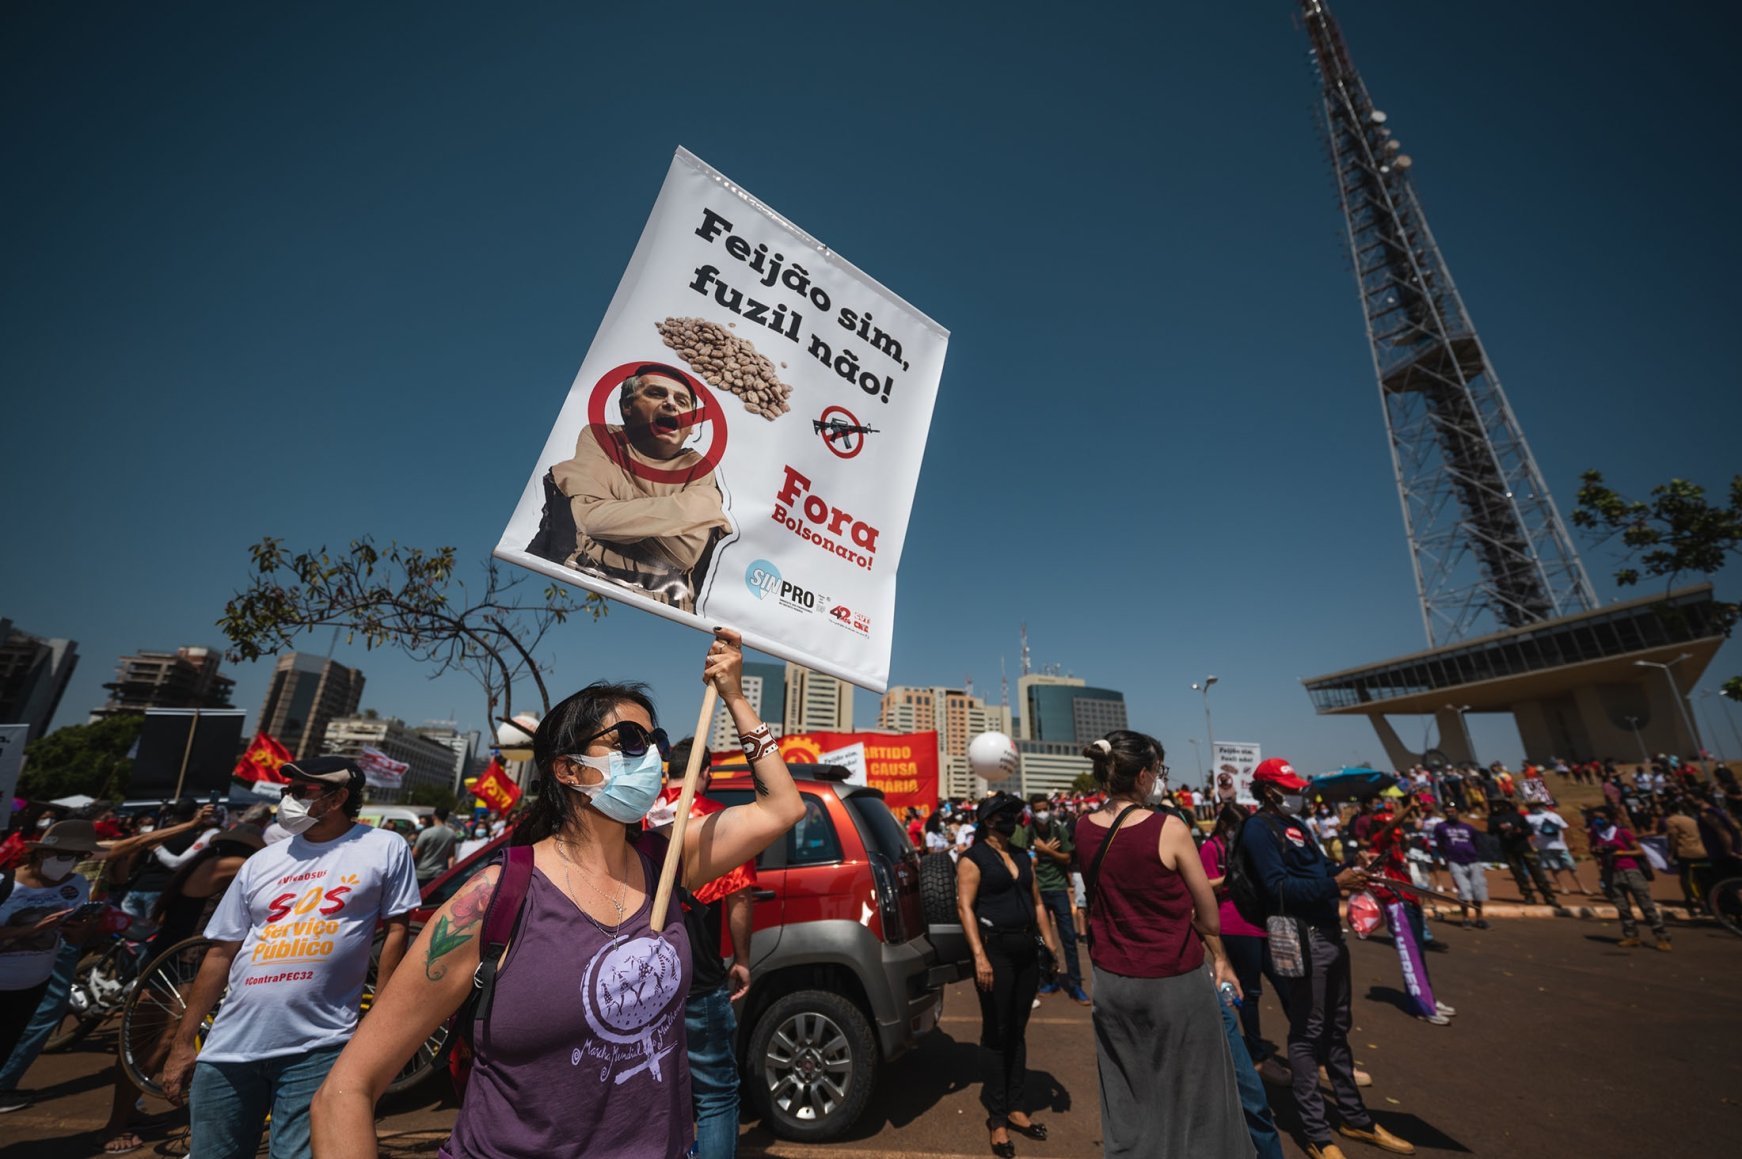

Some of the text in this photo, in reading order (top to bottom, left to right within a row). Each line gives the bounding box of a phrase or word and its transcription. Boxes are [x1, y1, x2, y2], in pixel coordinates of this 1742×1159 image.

[695, 207, 910, 373] Feijão sim,
[688, 264, 894, 404] fuzil não!
[776, 464, 880, 554] Fora
[771, 503, 874, 571] Bolsonaro!
[864, 746, 912, 760] ARTIDO
[870, 762, 918, 776] CAUSA
[266, 886, 352, 923] SOS
[261, 917, 339, 940] Serviço
[252, 938, 334, 961] Público
